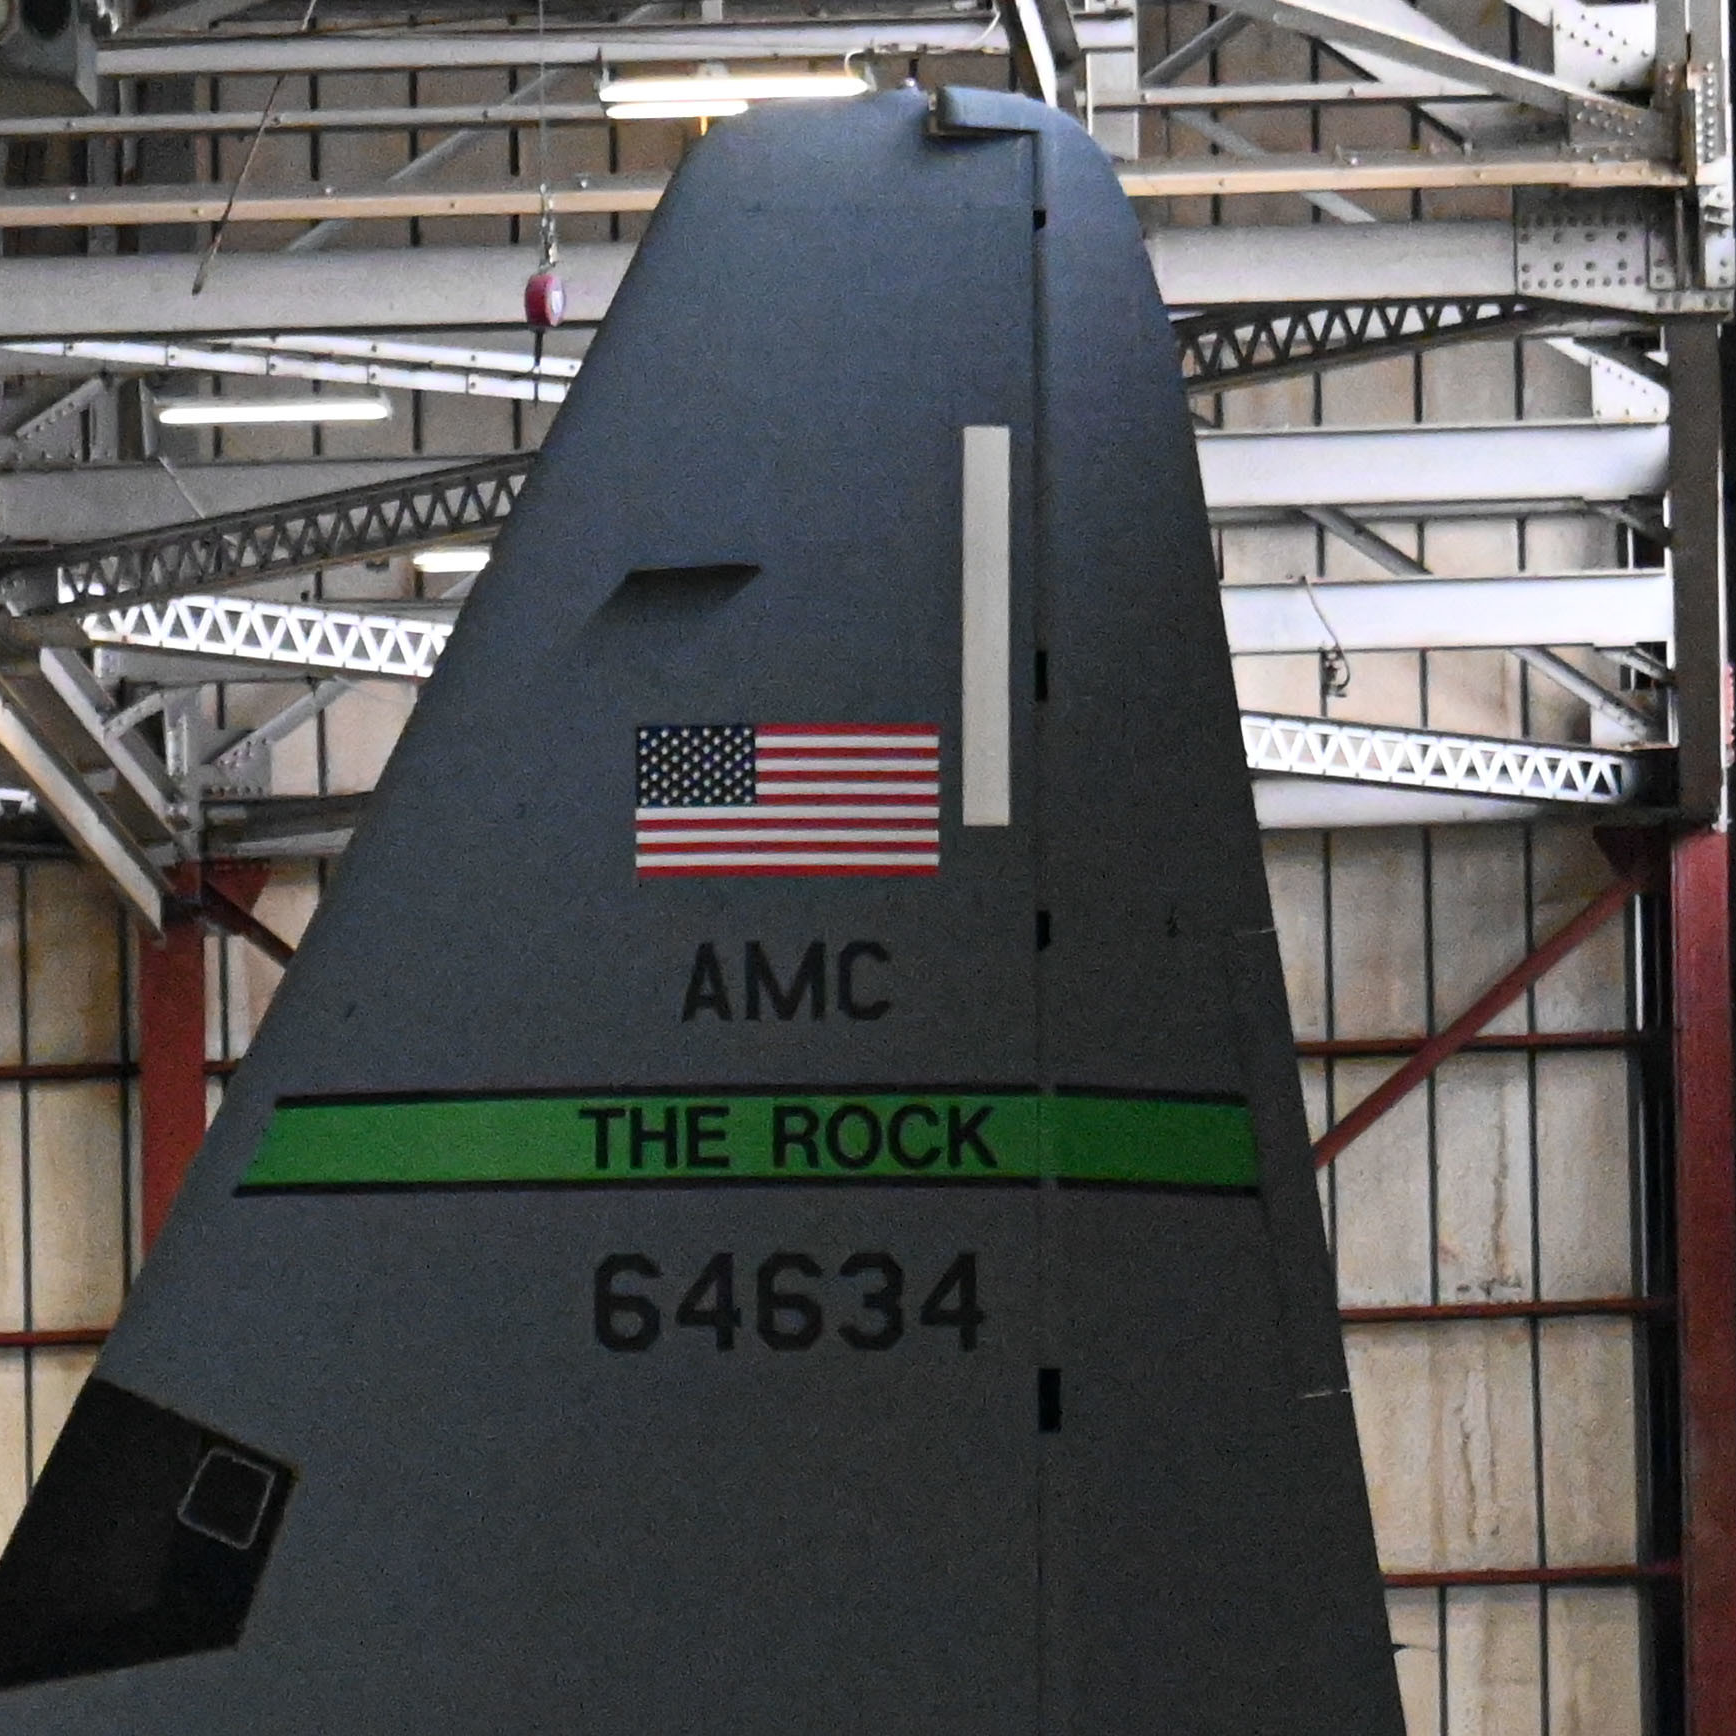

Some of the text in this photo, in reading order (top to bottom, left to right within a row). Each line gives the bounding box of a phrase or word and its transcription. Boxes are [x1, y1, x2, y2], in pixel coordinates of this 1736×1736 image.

[682, 940, 891, 1022] AMC
[579, 1104, 998, 1169] THE ROCK
[594, 1251, 984, 1352] 64634
